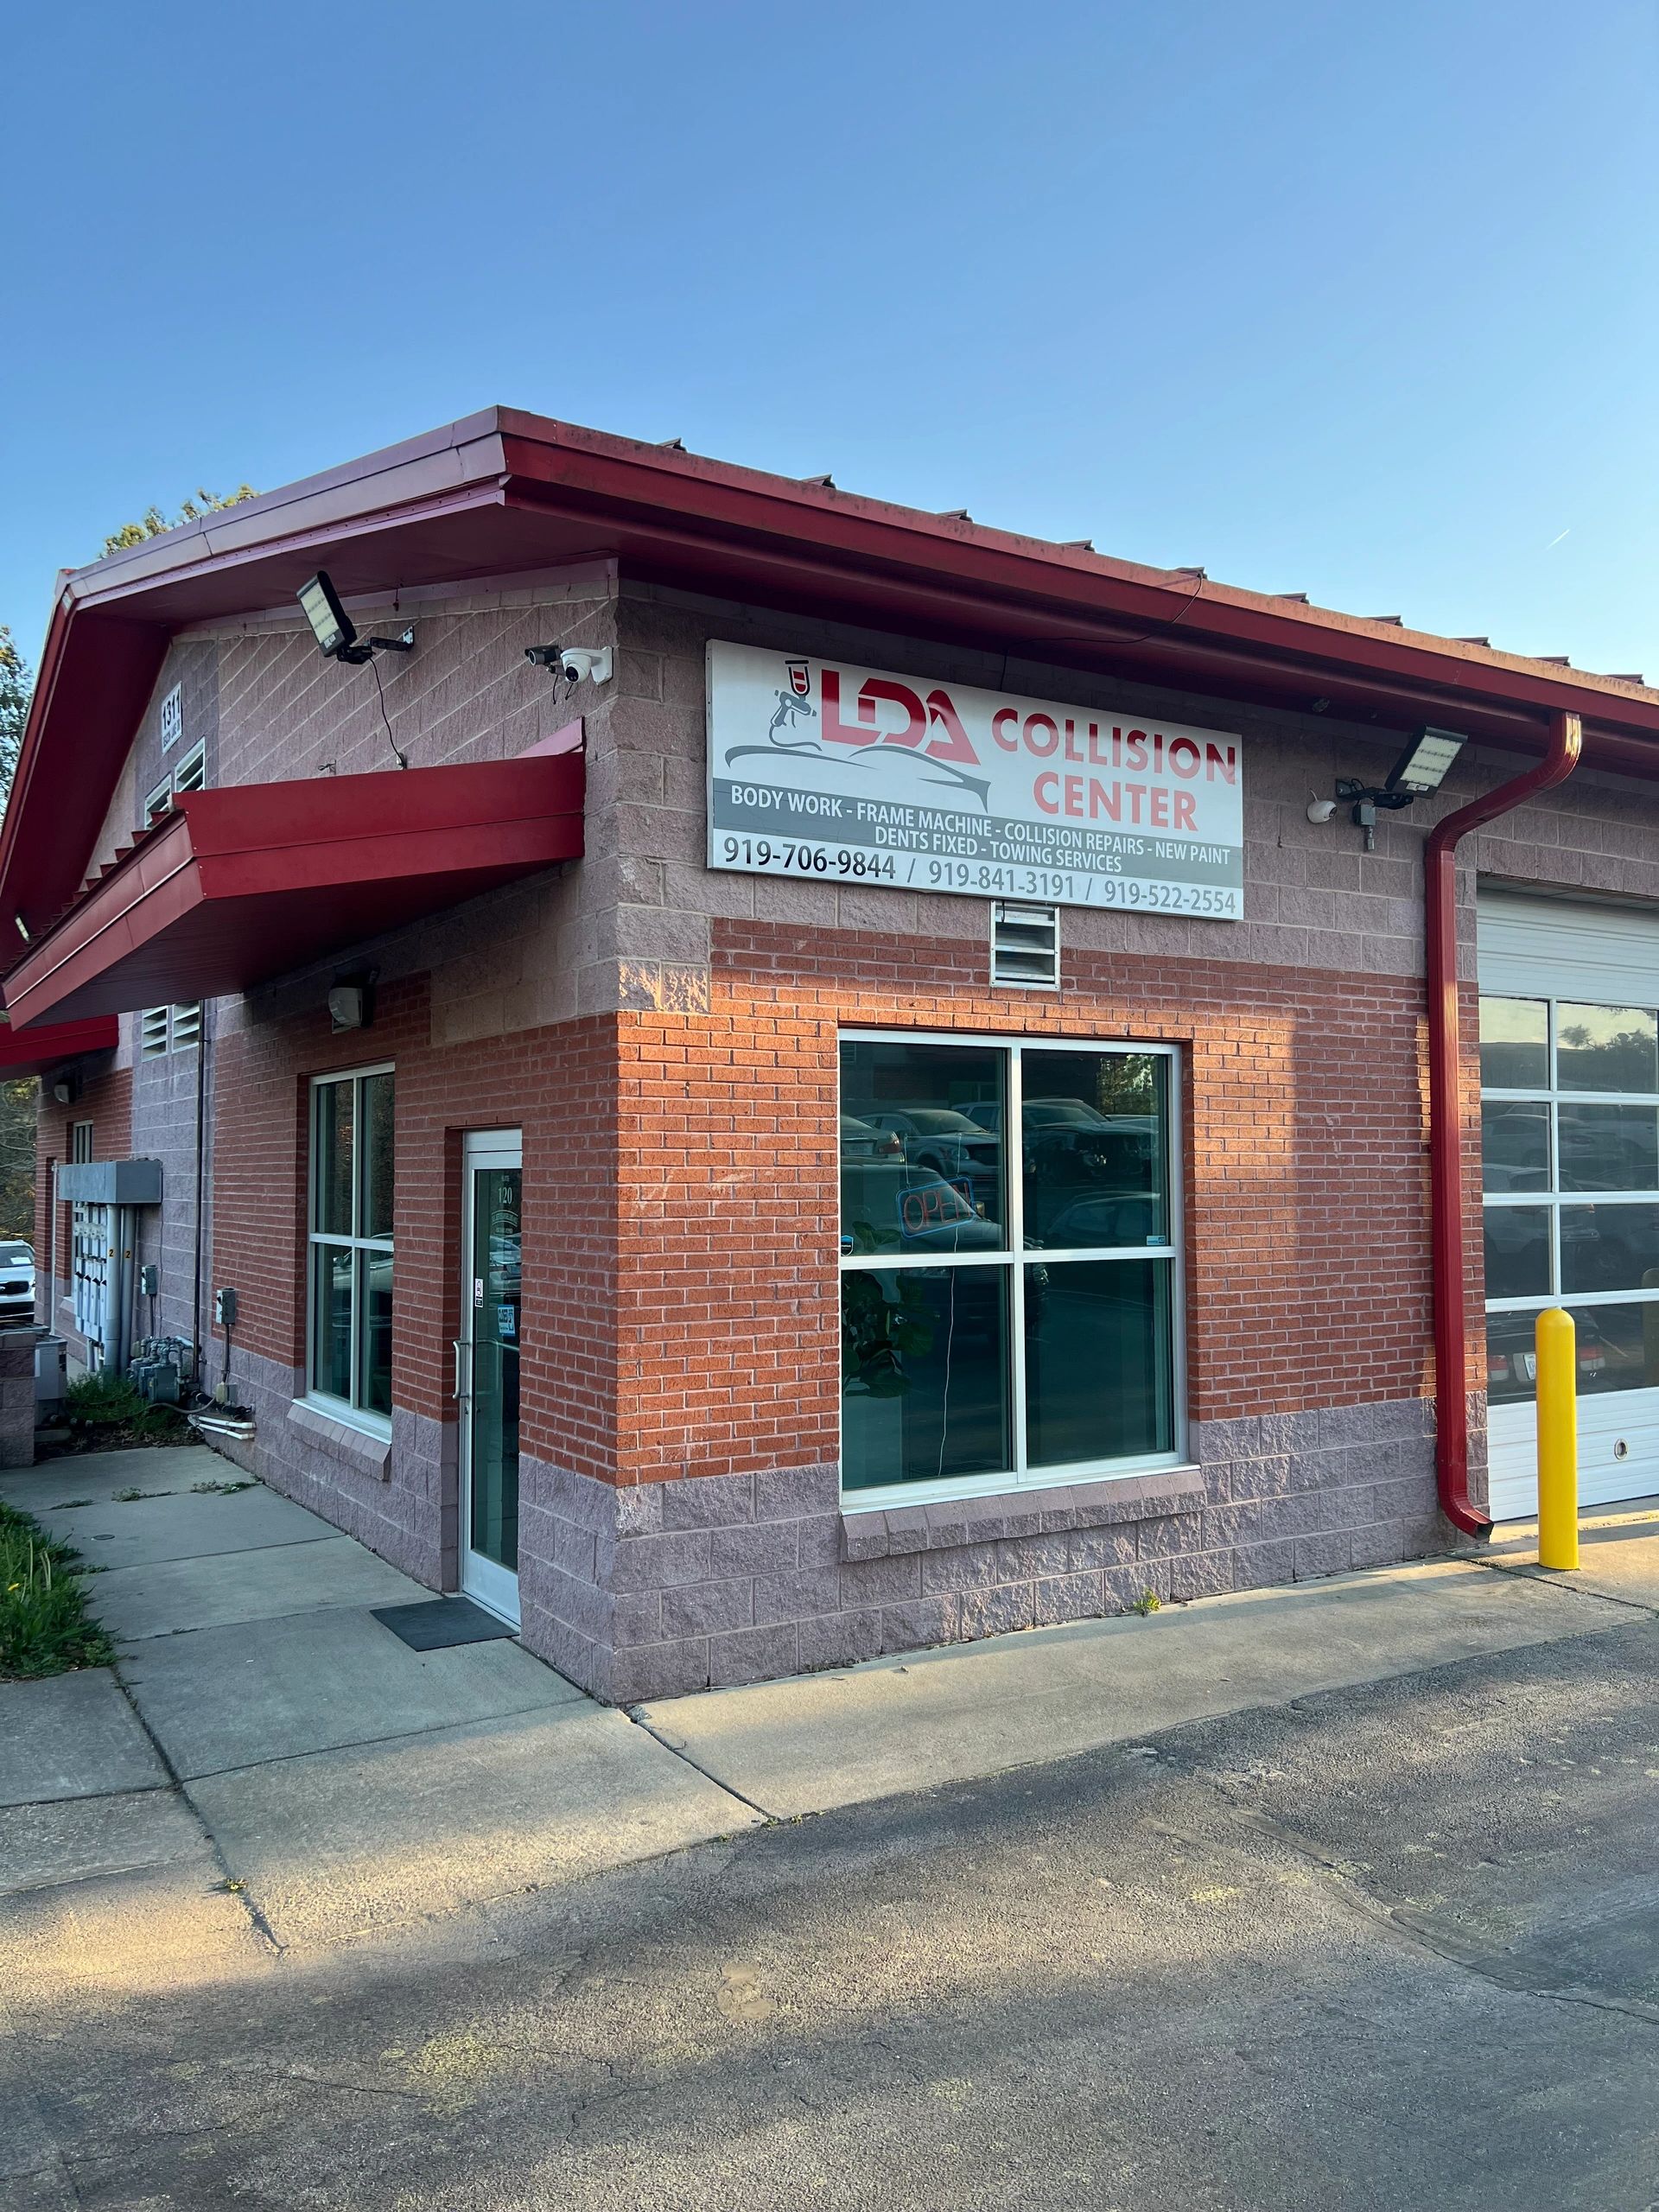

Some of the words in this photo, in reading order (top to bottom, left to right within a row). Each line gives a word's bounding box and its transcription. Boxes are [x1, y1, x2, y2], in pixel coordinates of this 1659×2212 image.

[163, 689, 181, 730] 1311
[822, 669, 981, 766] LDA
[992, 708, 1236, 785] COLLISION
[731, 785, 784, 810] BODY
[787, 792, 843, 818] WORK
[856, 802, 914, 827] FRAME
[918, 810, 993, 837] MACHINE
[1004, 823, 1082, 849] COLLISION
[1086, 833, 1144, 855] REPAIRS
[1155, 842, 1186, 860] NEW
[1190, 846, 1230, 865] PAINT
[1033, 771, 1198, 831] CENTER
[724, 836, 896, 880] 919-706-9844
[907, 858, 916, 883] /
[929, 860, 1073, 898] 919-841-3191
[1085, 878, 1092, 900] /
[1104, 880, 1236, 913] 919-522-2554
[875, 826, 929, 850] DENTS
[933, 834, 977, 855] FIXED
[989, 841, 1052, 865] TOWING
[1056, 849, 1122, 873] SERVICES
[498, 1186, 512, 1204] 120
[904, 1182, 971, 1230] OPEN
[109, 1249, 114, 1257] 2
